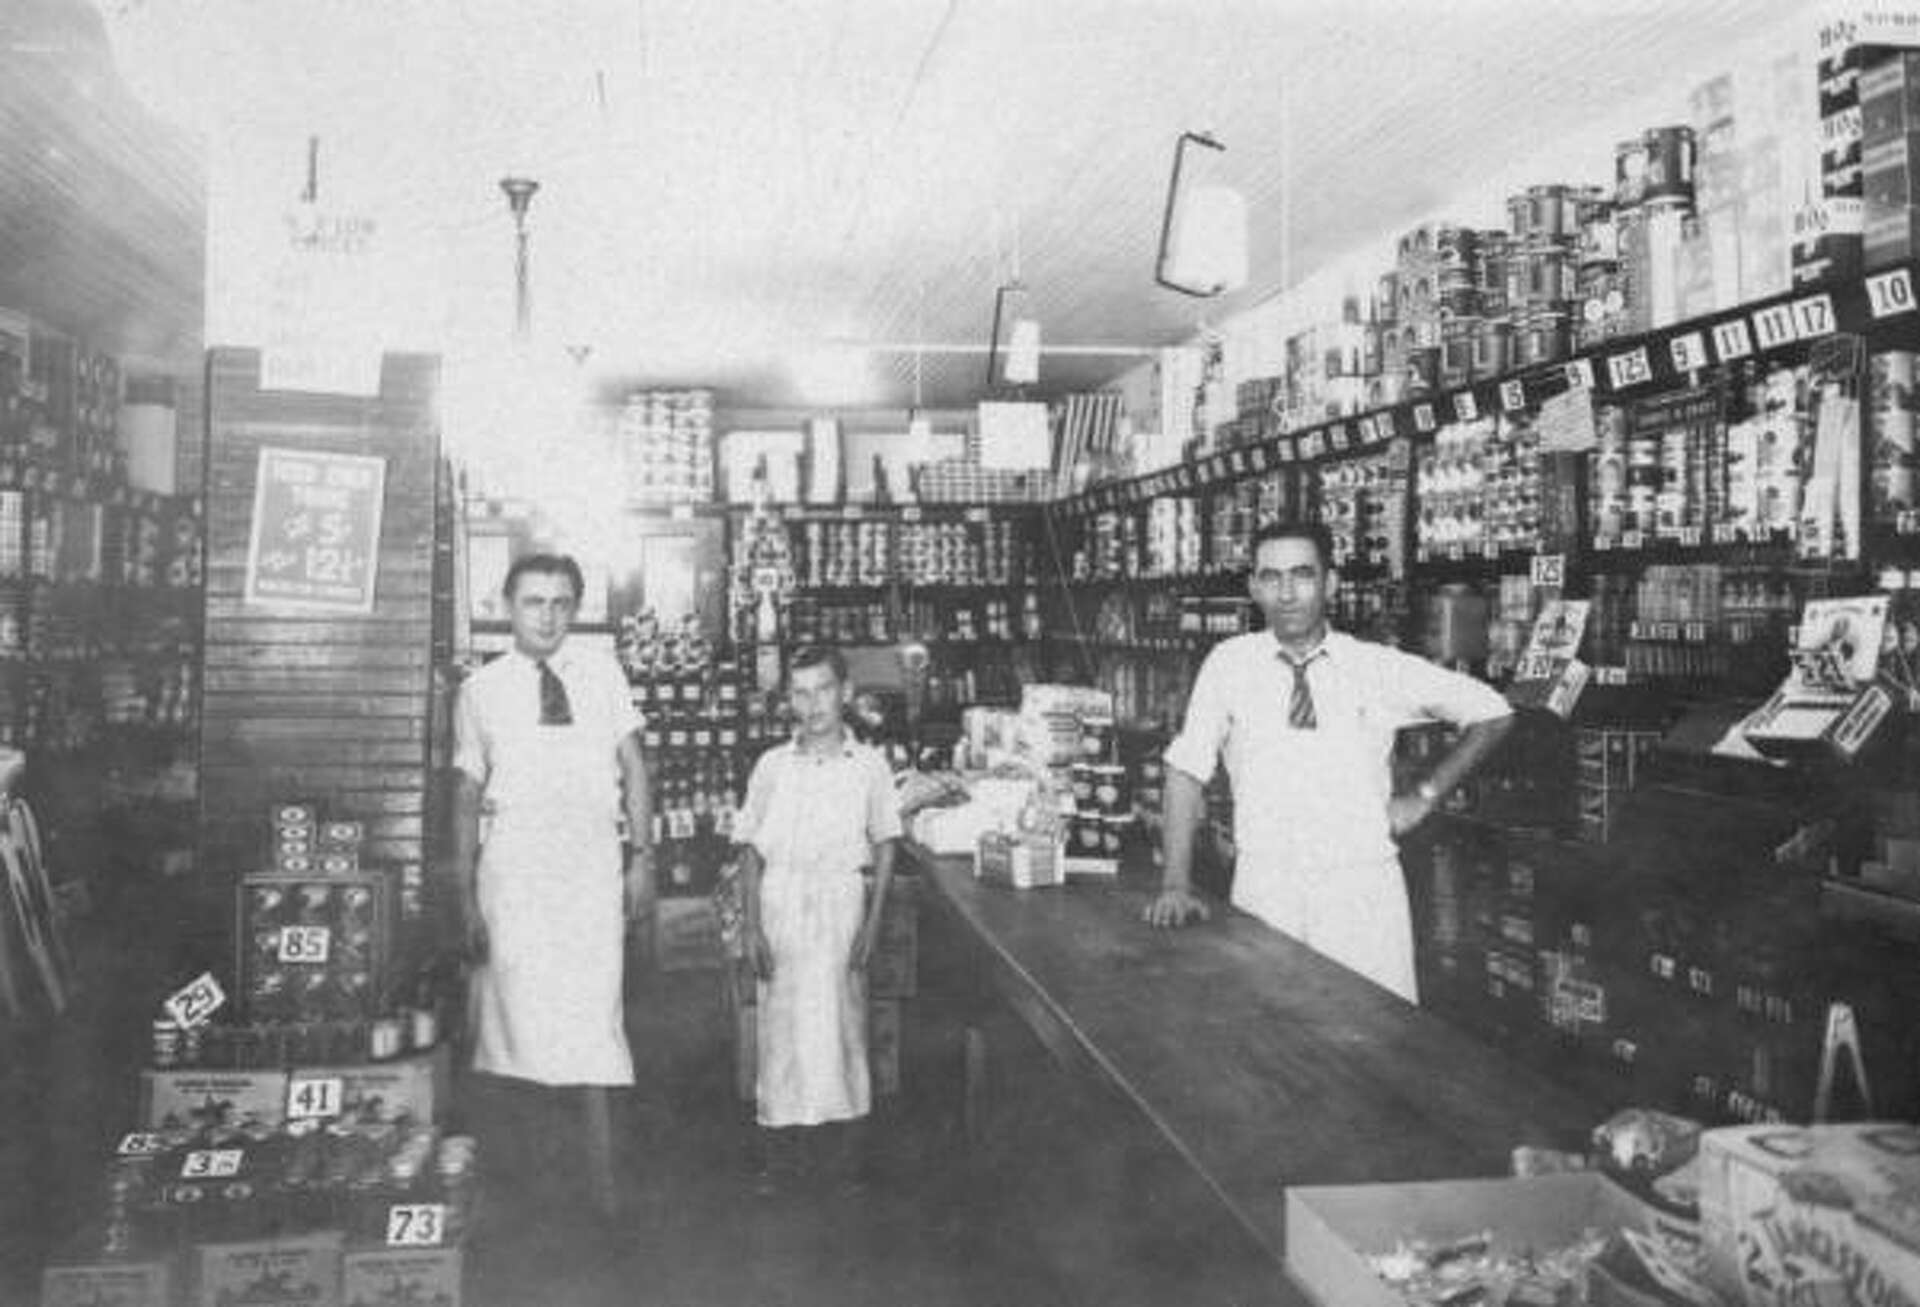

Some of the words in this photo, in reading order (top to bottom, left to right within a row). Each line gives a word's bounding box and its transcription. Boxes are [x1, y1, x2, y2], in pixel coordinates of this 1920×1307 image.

[1878, 277, 1909, 312] 10
[1763, 313, 1789, 343] 11
[1803, 301, 1828, 334] 17
[287, 930, 322, 956] 85
[175, 984, 215, 1020] 29
[297, 1083, 328, 1111] 41
[394, 1209, 437, 1241] 73
